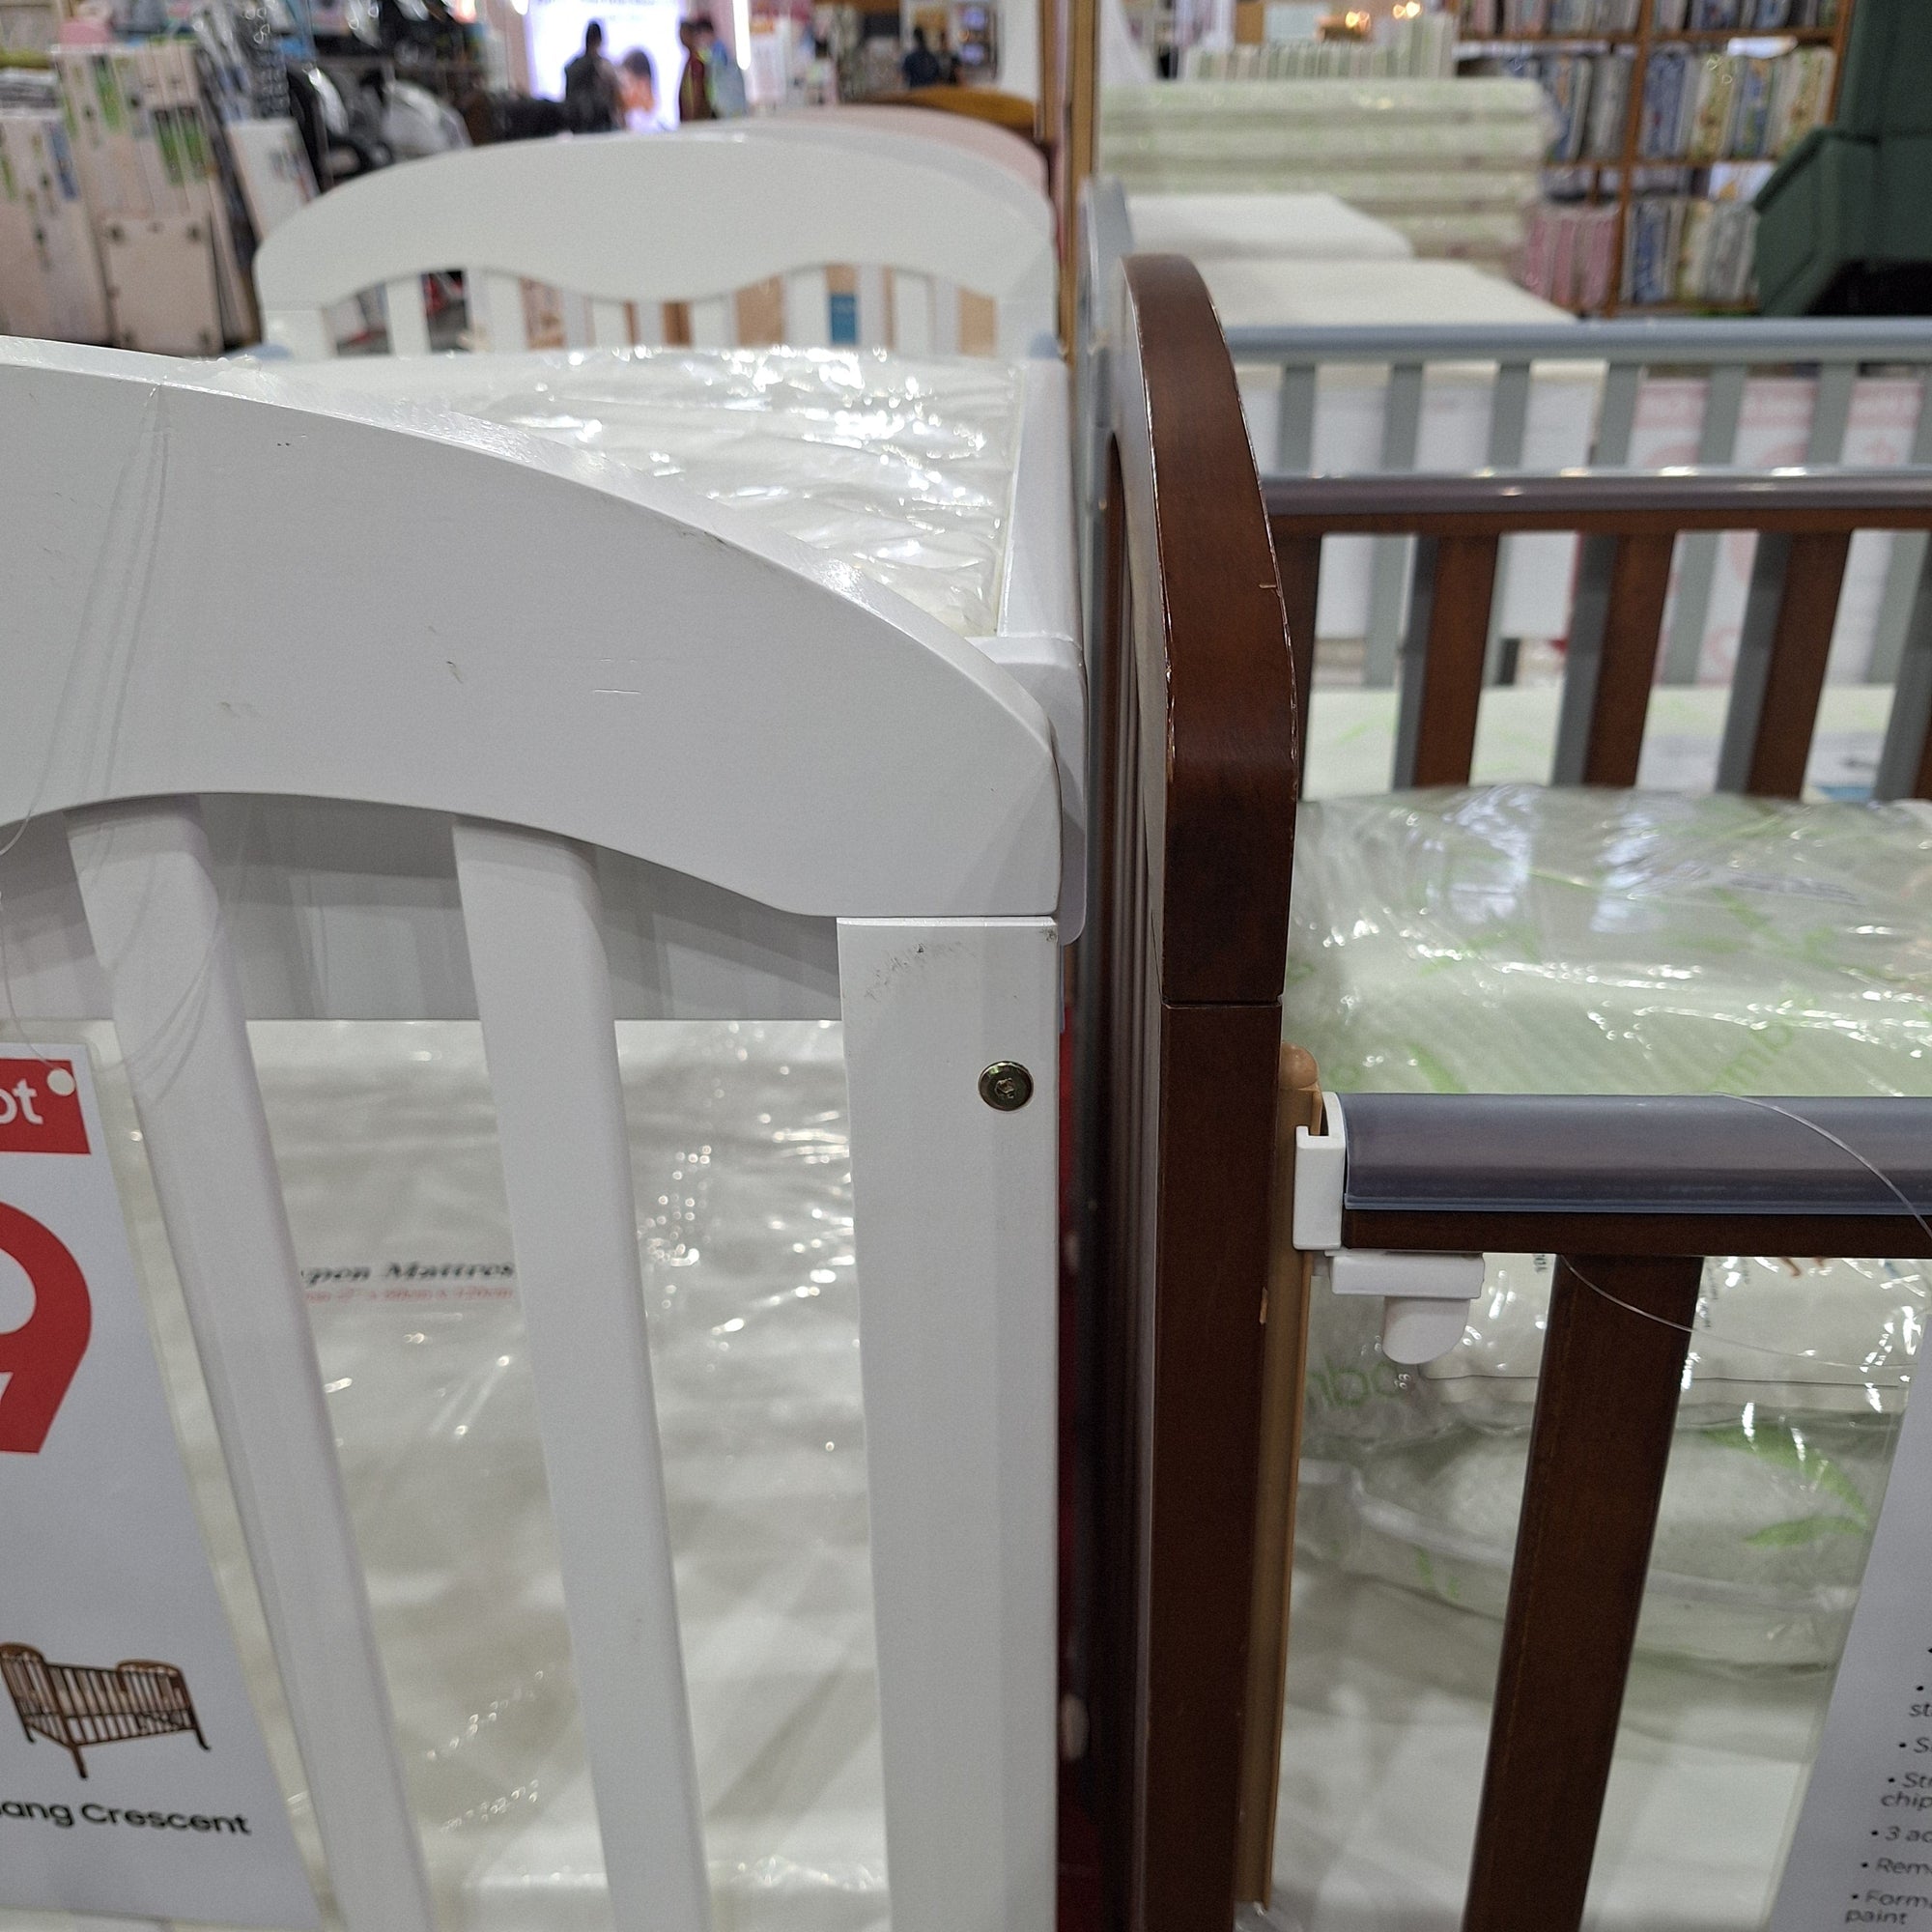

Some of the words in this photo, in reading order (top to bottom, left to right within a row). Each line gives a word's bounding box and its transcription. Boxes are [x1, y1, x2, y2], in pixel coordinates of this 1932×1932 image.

[300, 1266, 371, 1286] pen
[1909, 1702, 1932, 1718] st
[0, 1800, 74, 1829] ang
[81, 1803, 252, 1835] Crescent
[1884, 1825, 1900, 1841] 3
[1865, 1889, 1932, 1908] Form
[1844, 1909, 1908, 1925] paint
